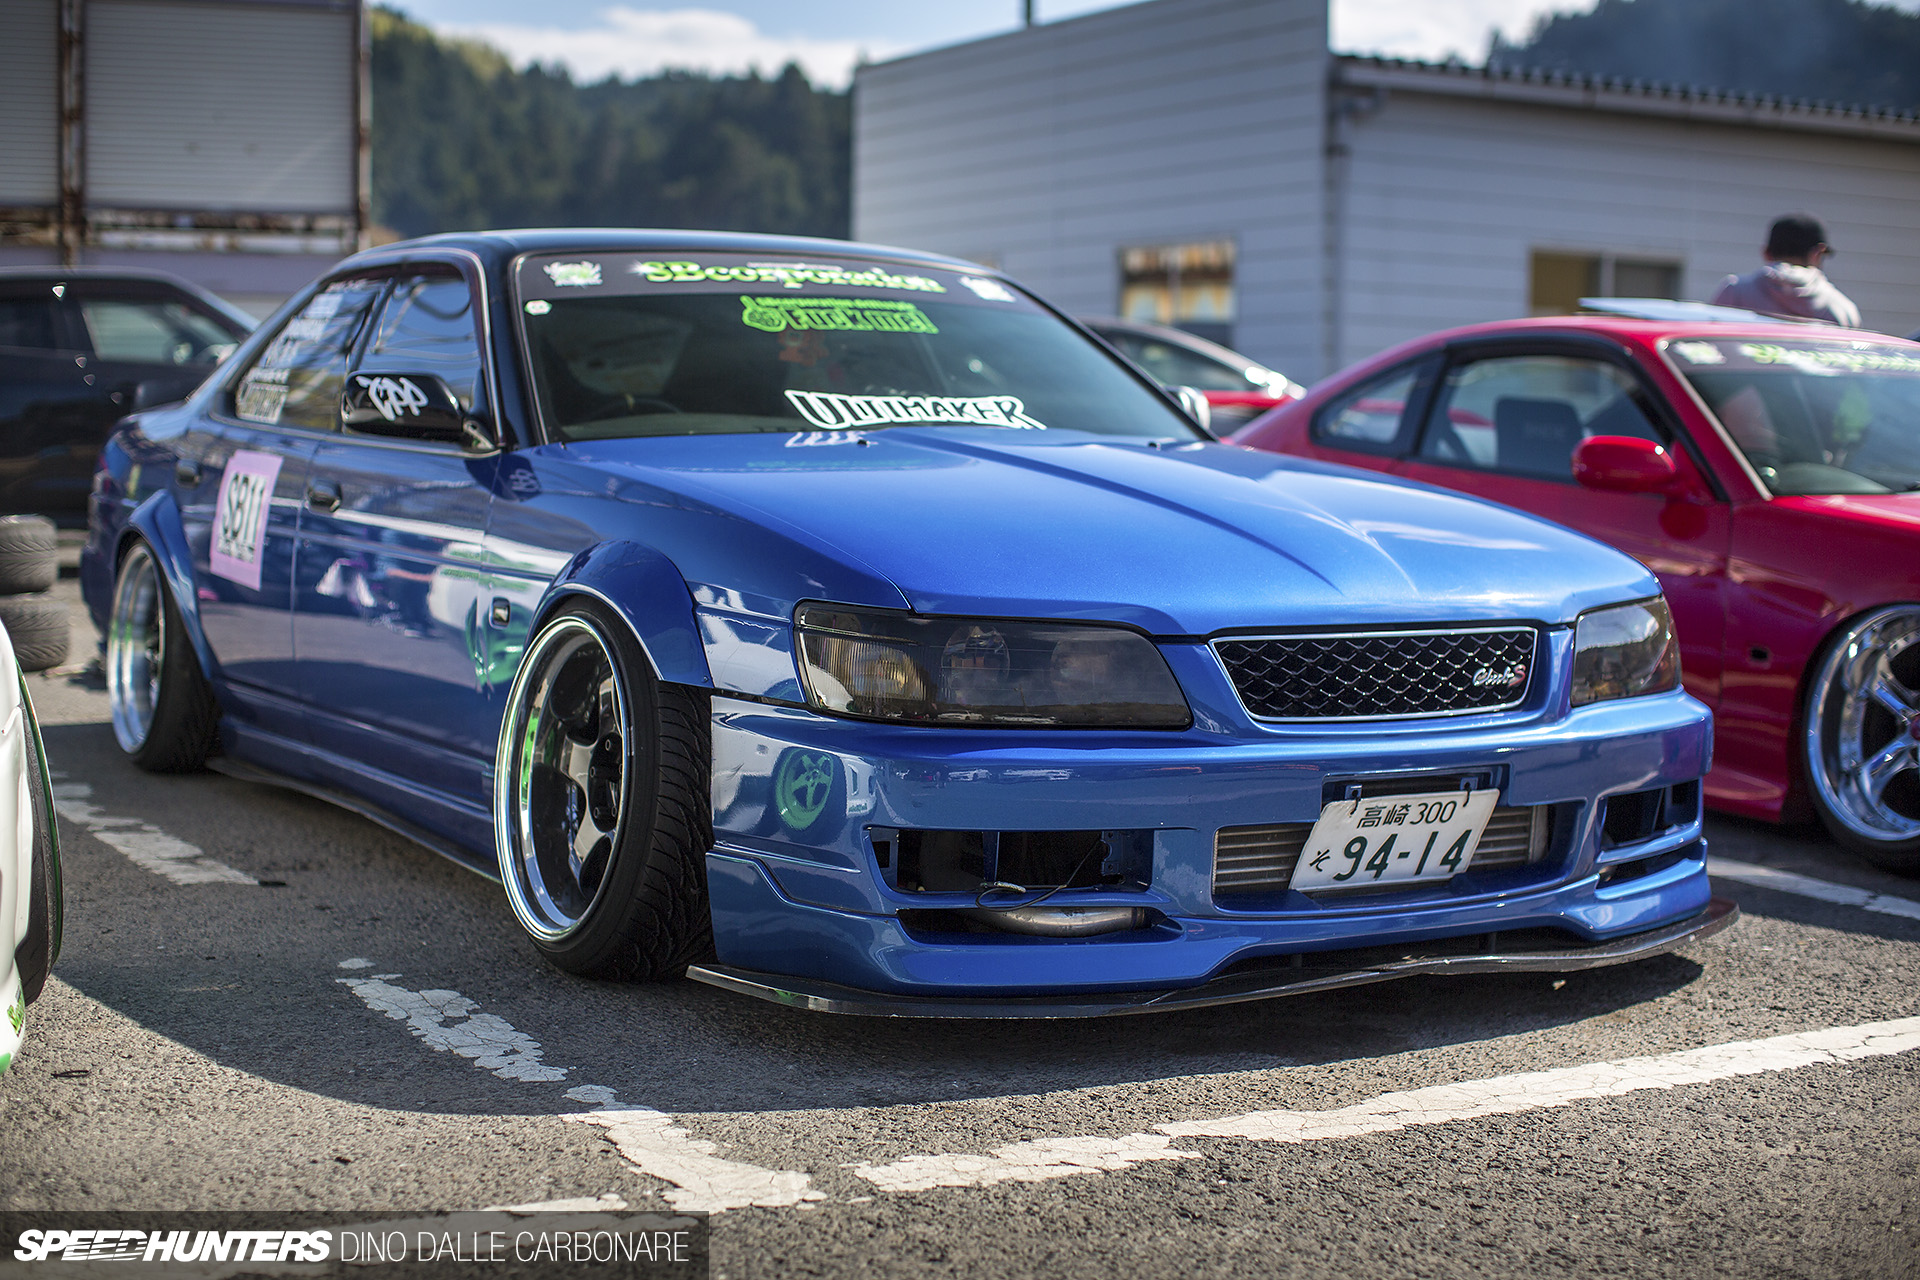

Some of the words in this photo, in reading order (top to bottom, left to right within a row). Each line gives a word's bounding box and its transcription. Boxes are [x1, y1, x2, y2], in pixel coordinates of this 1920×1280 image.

[1356, 803, 1409, 829] 高崎
[1409, 801, 1457, 826] 300
[1333, 829, 1472, 881] 94-14
